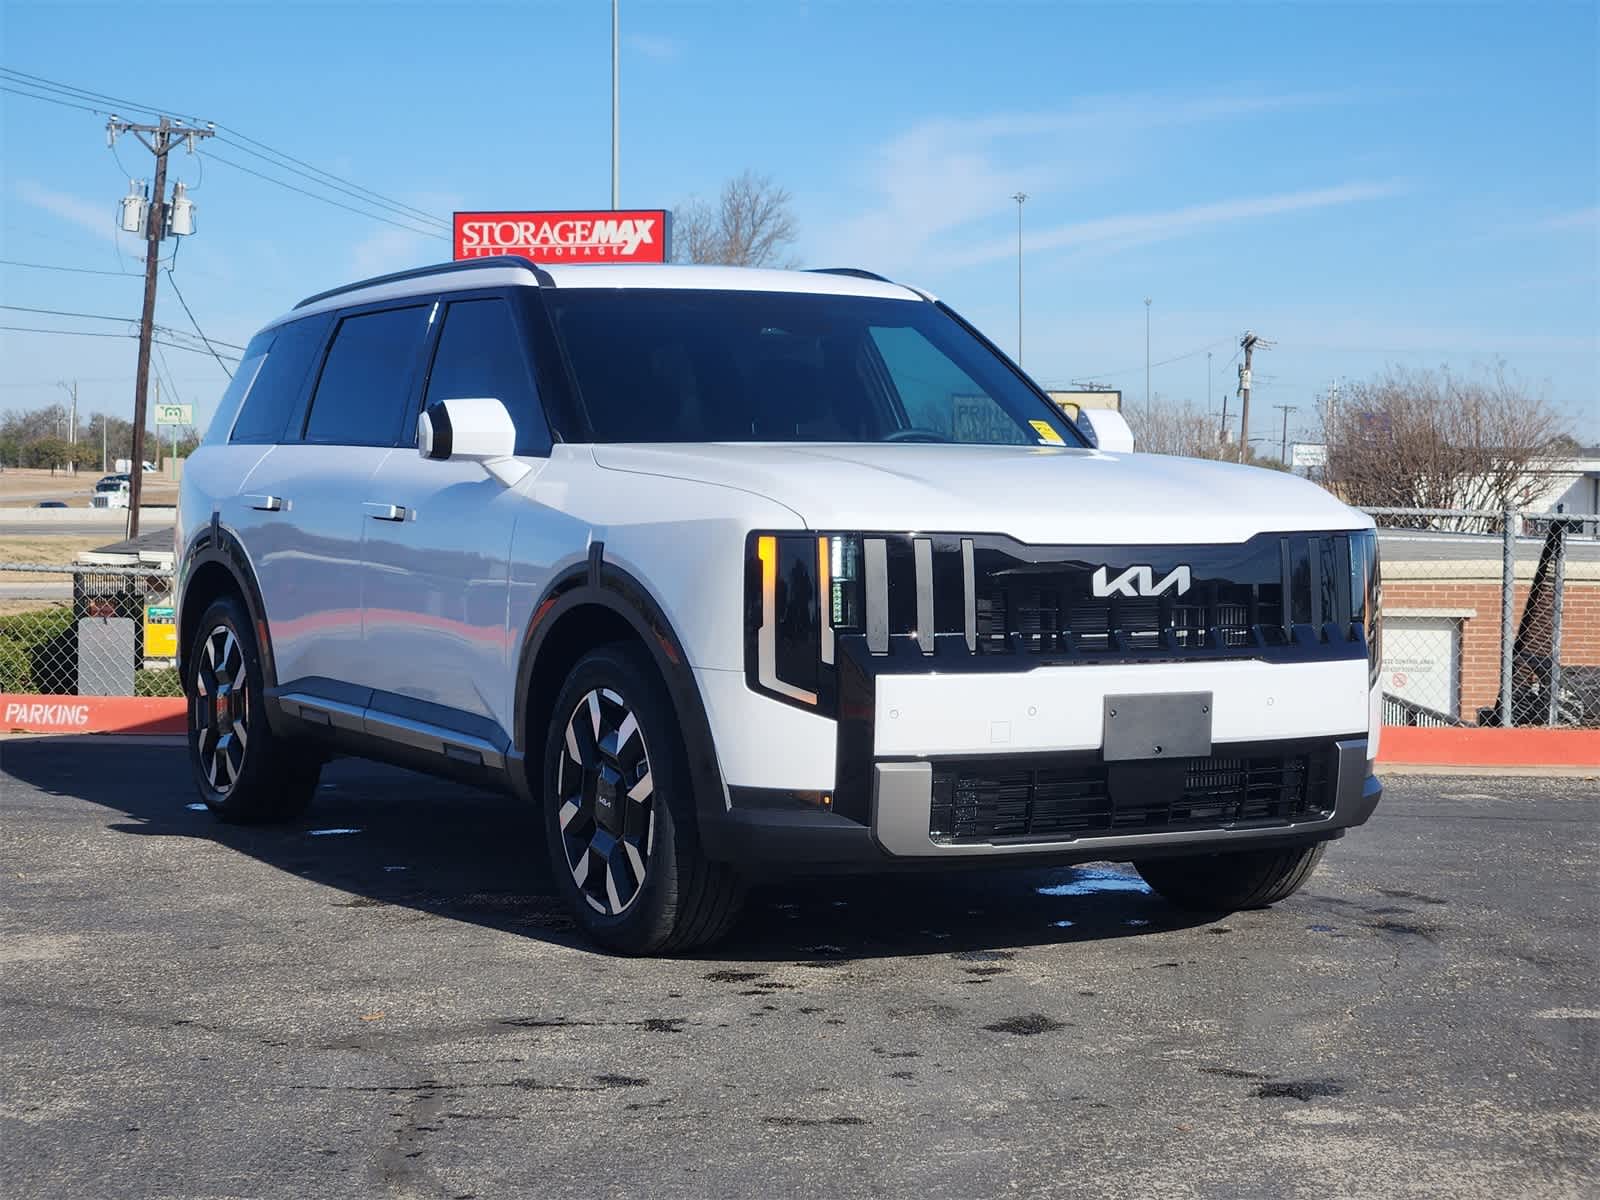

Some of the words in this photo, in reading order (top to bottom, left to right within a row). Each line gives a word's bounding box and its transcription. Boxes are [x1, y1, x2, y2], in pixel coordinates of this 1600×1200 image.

[529, 247, 618, 255] STORAGE
[1093, 565, 1190, 596] KIA
[5, 703, 89, 725] PARKING
